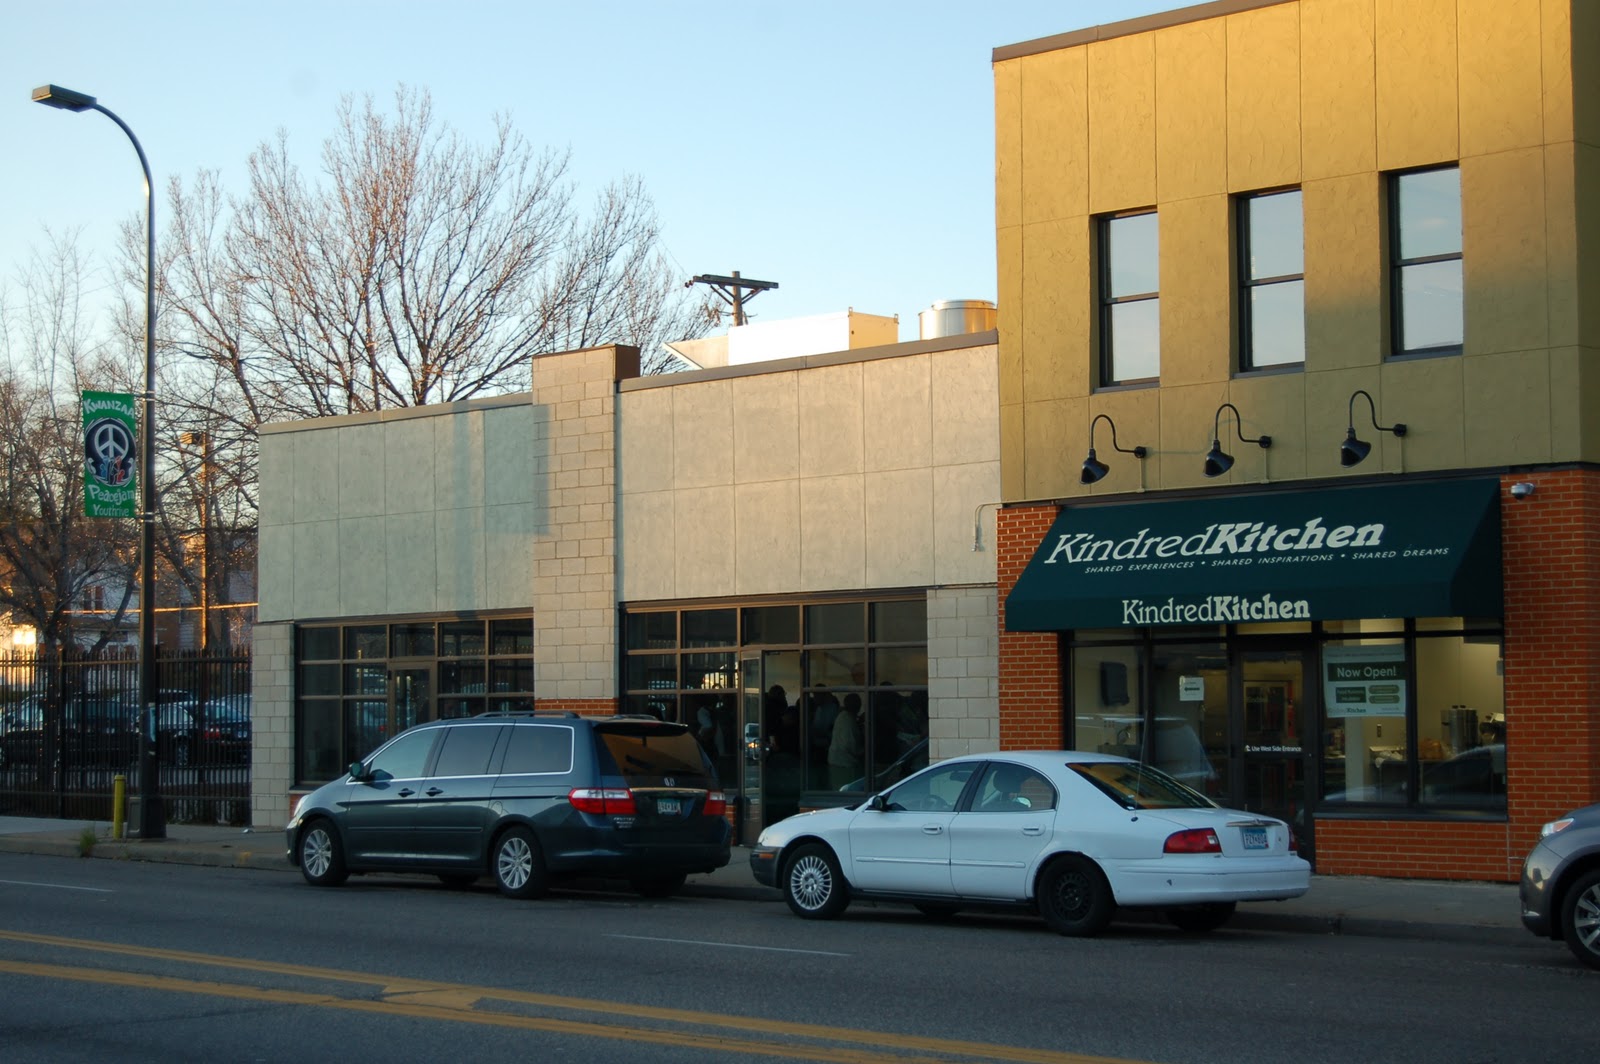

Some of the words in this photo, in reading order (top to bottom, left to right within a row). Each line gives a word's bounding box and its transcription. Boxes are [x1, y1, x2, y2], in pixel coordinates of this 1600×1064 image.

[1044, 517, 1384, 564] KindredKitchen
[1085, 565, 1123, 574] SHARED
[1128, 561, 1195, 571] EXPERIENCES
[1211, 558, 1253, 567] SHARED
[1258, 554, 1334, 564] INSPIRATIONS
[1352, 551, 1397, 560] SHARED
[1403, 547, 1449, 557] DREAMS
[1122, 593, 1311, 624] KindredKitchen
[1337, 667, 1360, 678] Now
[1363, 665, 1397, 679] Open!
